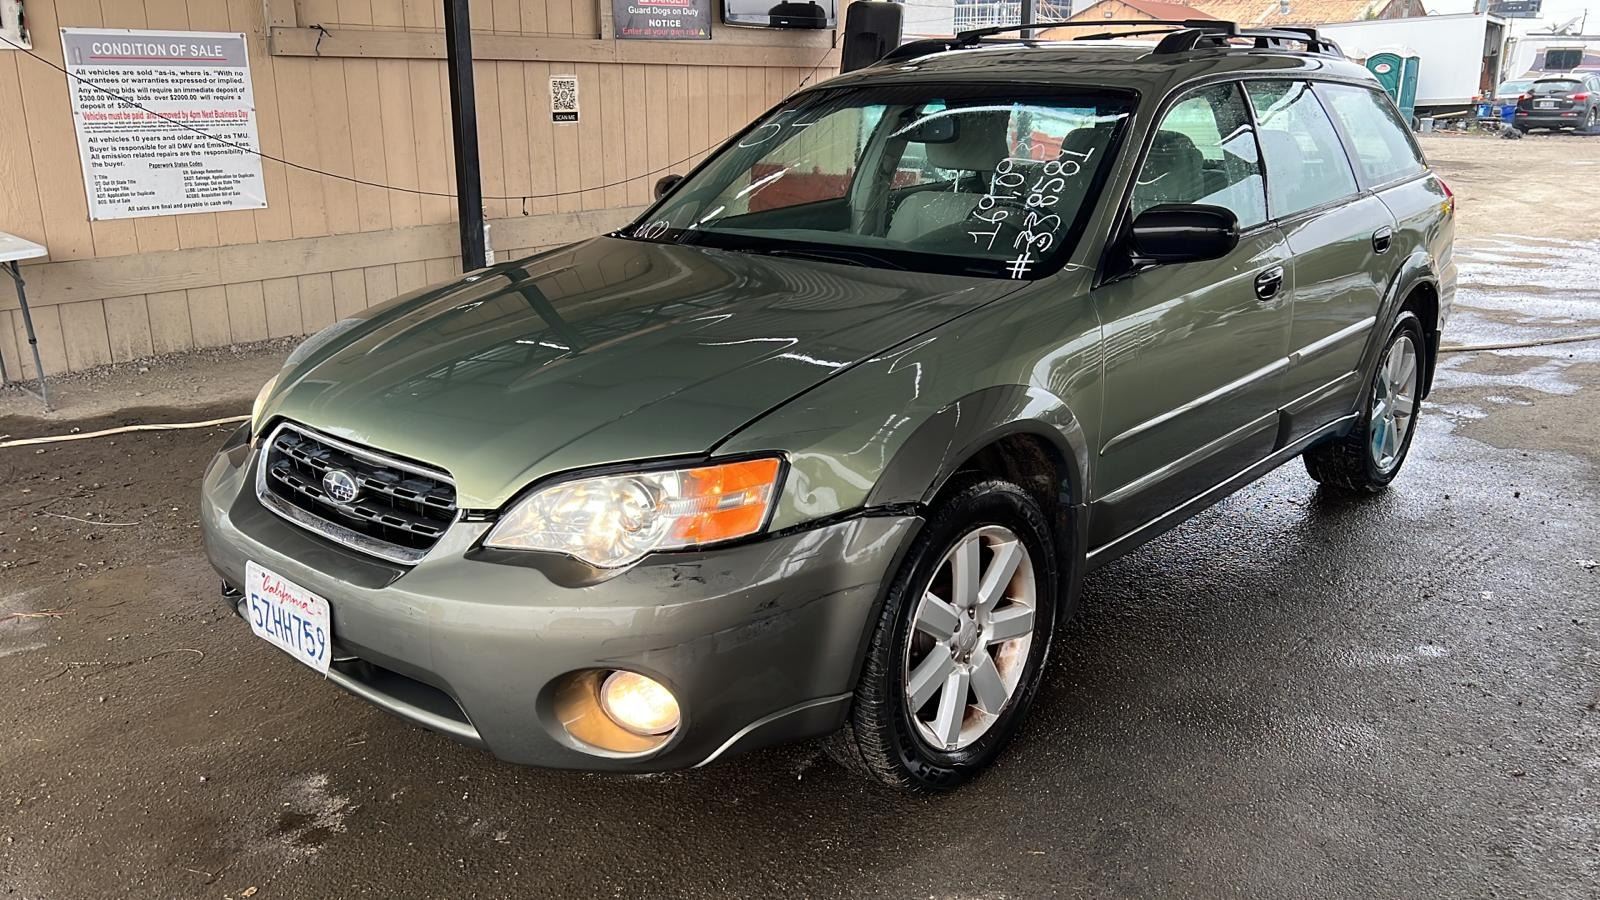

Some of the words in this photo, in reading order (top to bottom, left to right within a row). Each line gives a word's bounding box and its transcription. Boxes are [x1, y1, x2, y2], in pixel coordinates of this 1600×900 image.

[628, 6, 651, 14] Guard
[653, 7, 671, 16] Dogs
[683, 8, 698, 17] Duty
[92, 43, 167, 56] CONDITION
[170, 44, 188, 56] OF
[191, 45, 223, 57] SALE
[82, 112, 107, 120] Vehicles
[108, 112, 122, 120] must
[123, 112, 130, 120] be
[132, 111, 144, 120] paid
[181, 111, 188, 120] by
[190, 110, 200, 119] 4pm
[201, 110, 214, 118] Next
[214, 110, 238, 118] Business
[239, 110, 248, 119] Day
[119, 144, 156, 152] responsible
[263, 576, 314, 615] California
[251, 592, 325, 660] 5ZHH759
